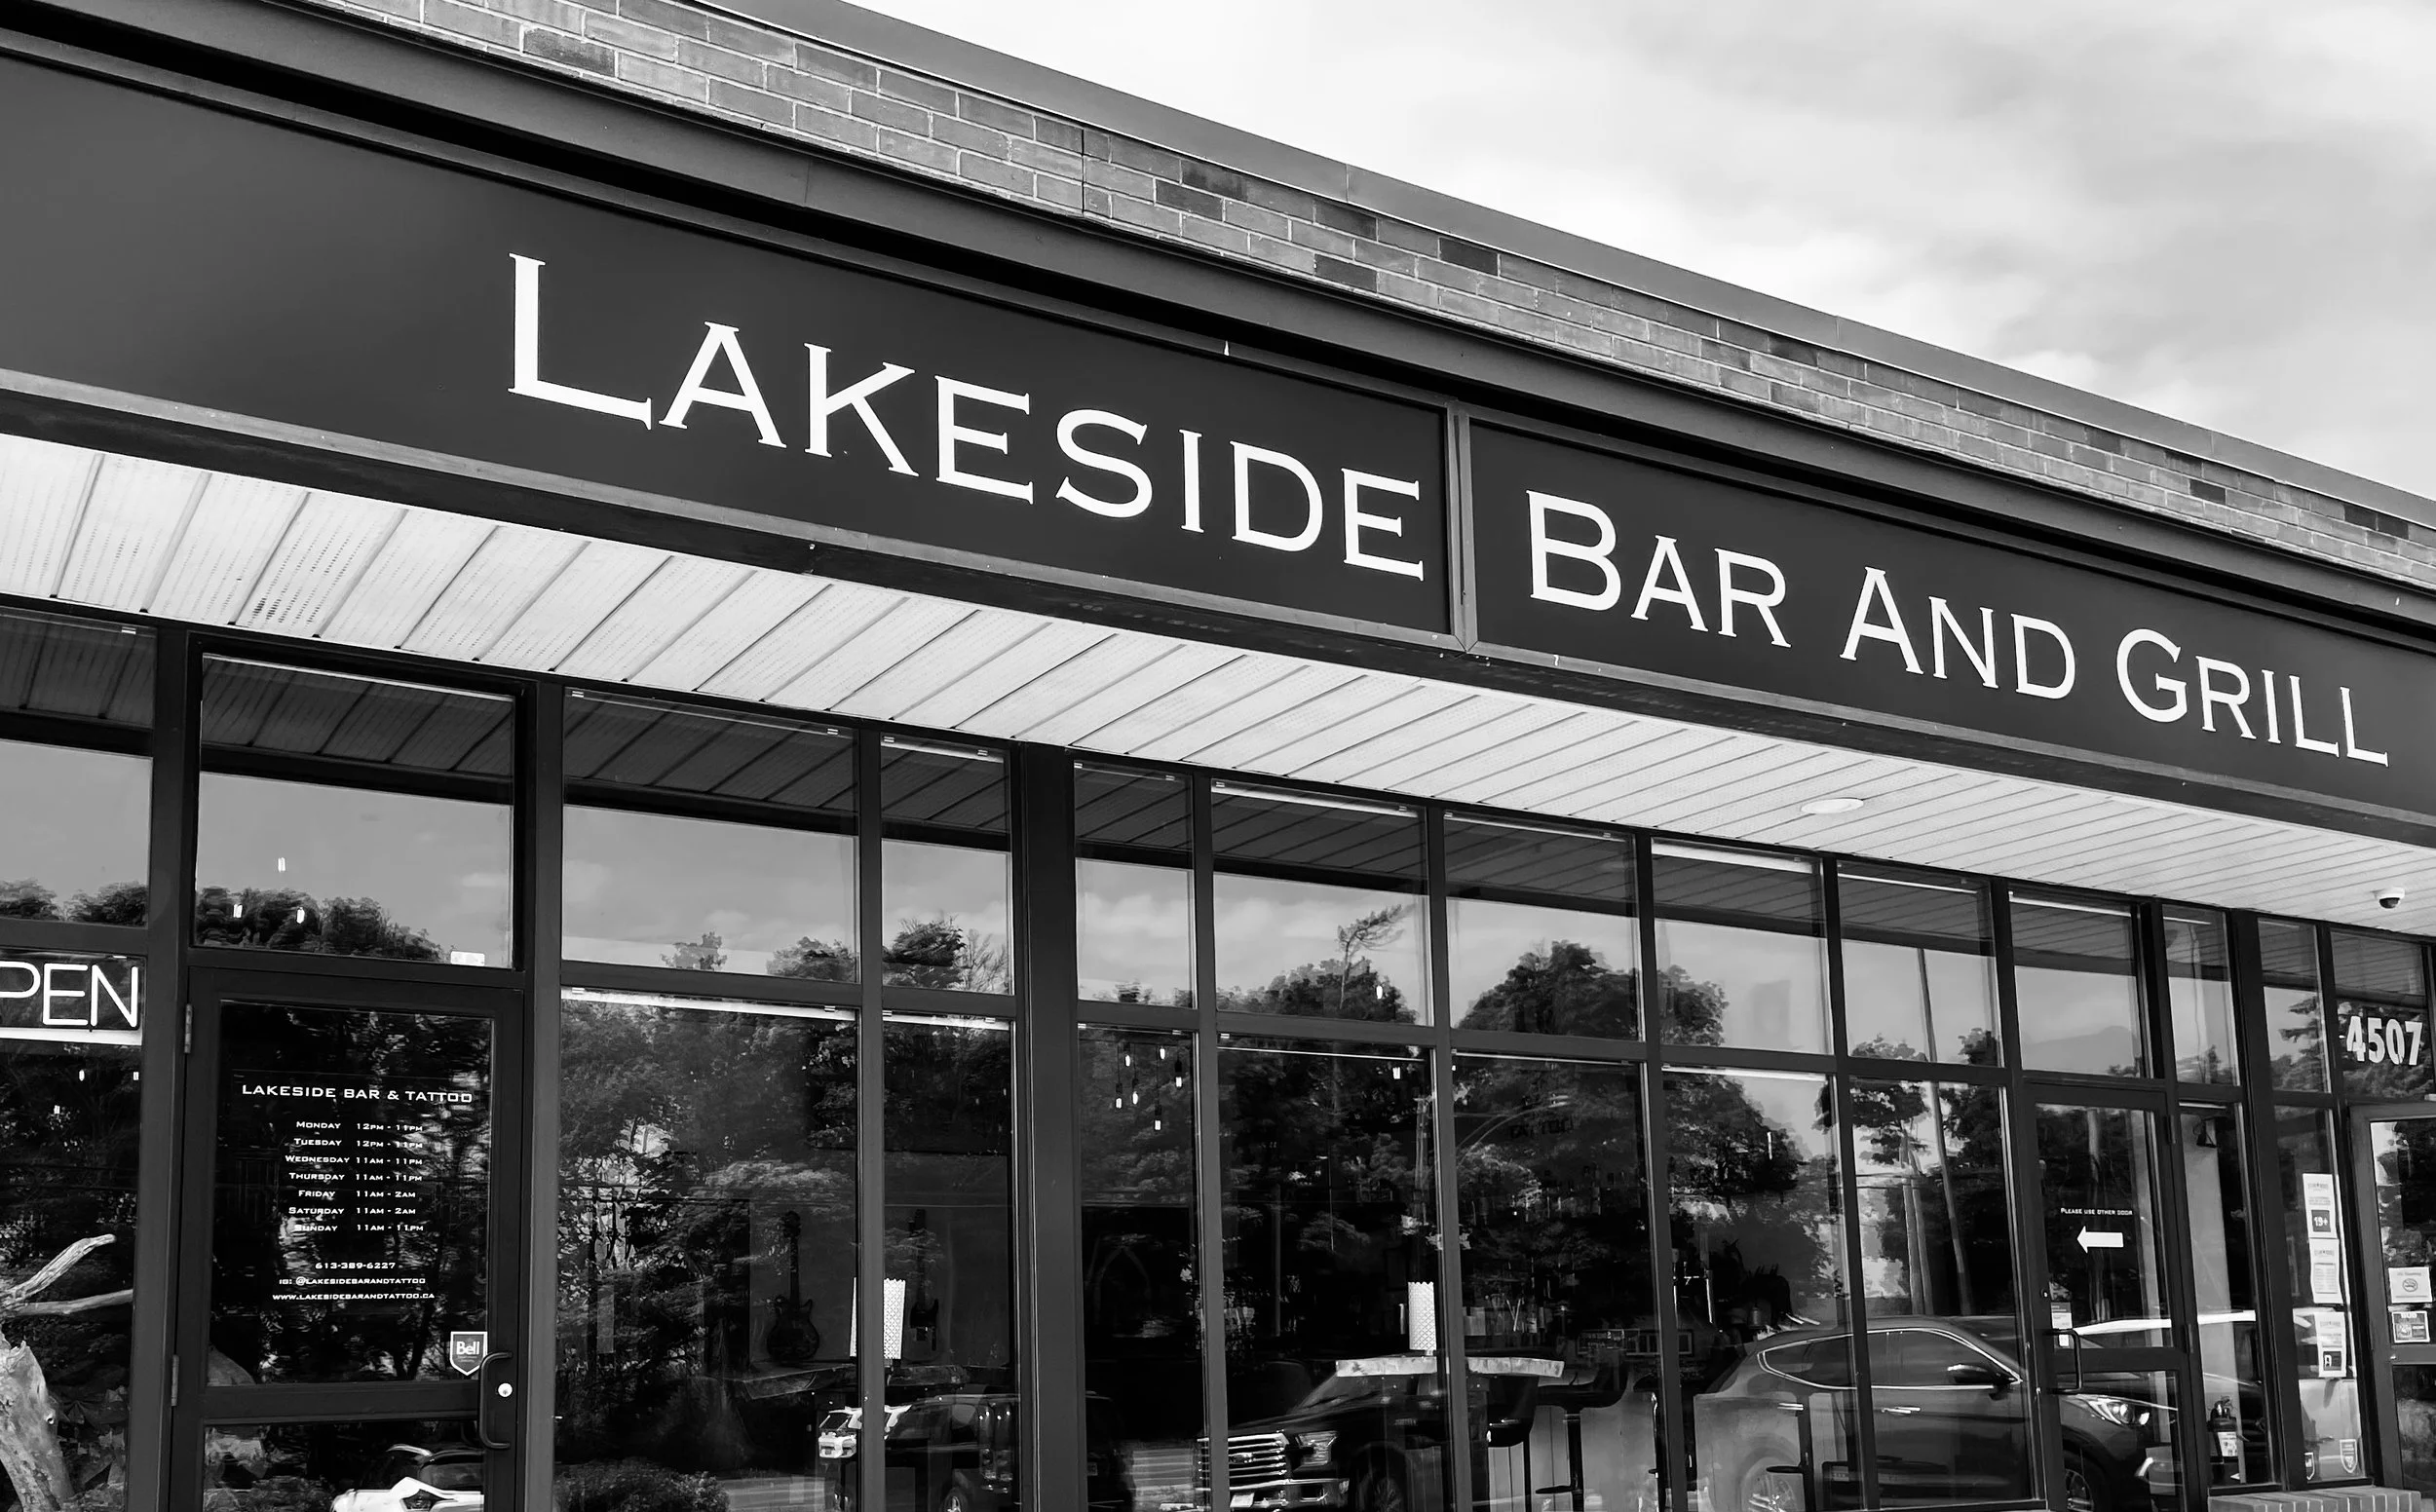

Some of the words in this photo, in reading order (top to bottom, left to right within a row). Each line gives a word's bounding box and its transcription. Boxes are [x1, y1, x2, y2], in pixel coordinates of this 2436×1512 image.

[508, 252, 1424, 581] LAKESIDE
[1526, 490, 1791, 648] BAR
[1840, 566, 2076, 699] AND
[2116, 628, 2389, 767] GRILL
[0, 961, 138, 1028] PEN
[2346, 1015, 2423, 1065] 4507
[243, 1084, 337, 1098] LAKESIDE
[343, 1088, 380, 1100] BAR
[387, 1090, 400, 1101] &
[404, 1090, 473, 1103] TATTOO
[285, 1154, 350, 1163] WEDNESDAY
[295, 1276, 426, 1286] @LAKESIDEBARANDTATTOO
[456, 1341, 480, 1355] Bell
